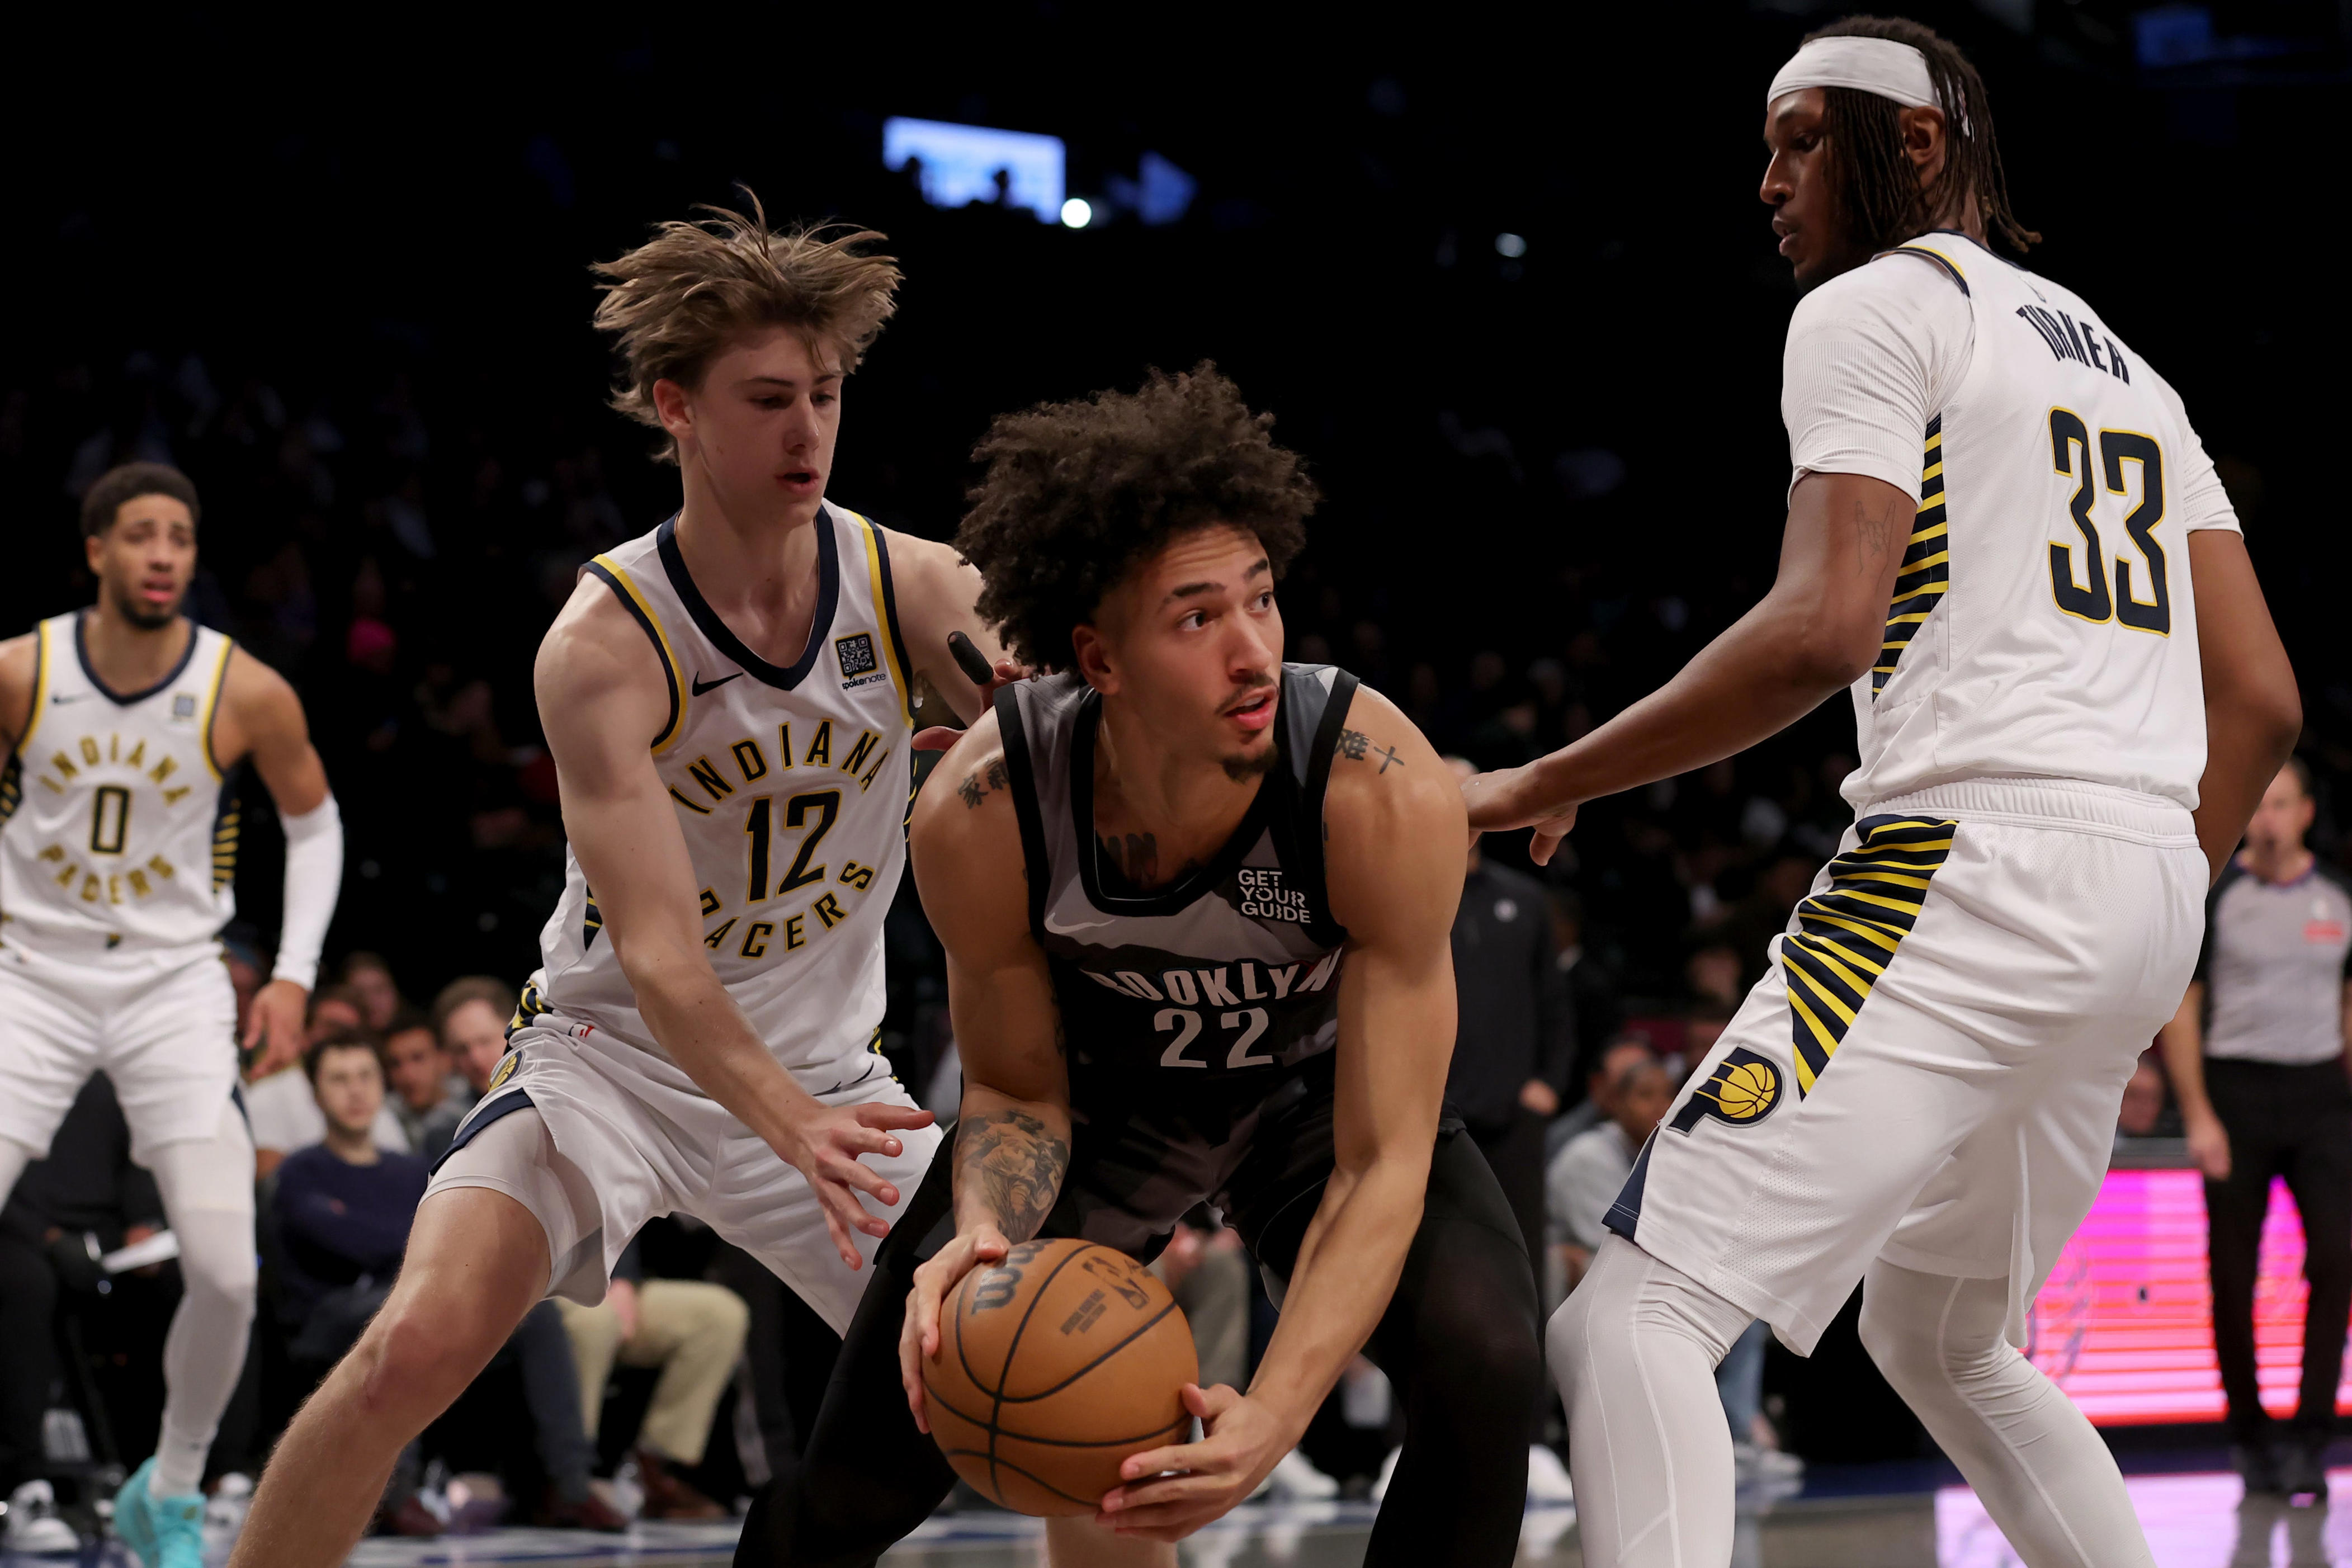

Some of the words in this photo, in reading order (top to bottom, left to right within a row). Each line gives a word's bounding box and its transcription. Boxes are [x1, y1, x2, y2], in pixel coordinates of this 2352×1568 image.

[2015, 304, 2130, 386] TURNER
[2047, 405, 2171, 638] 33
[842, 673, 886, 692] spokenote
[39, 733, 191, 805] INDIANA
[669, 718, 890, 815] INDIANA
[91, 784, 131, 855] 0
[744, 786, 842, 906] 12
[1238, 868, 1283, 887] GET
[1239, 886, 1306, 909] YOUR
[1241, 901, 1311, 924] GUIDE
[1154, 1007, 1274, 1069] 22
